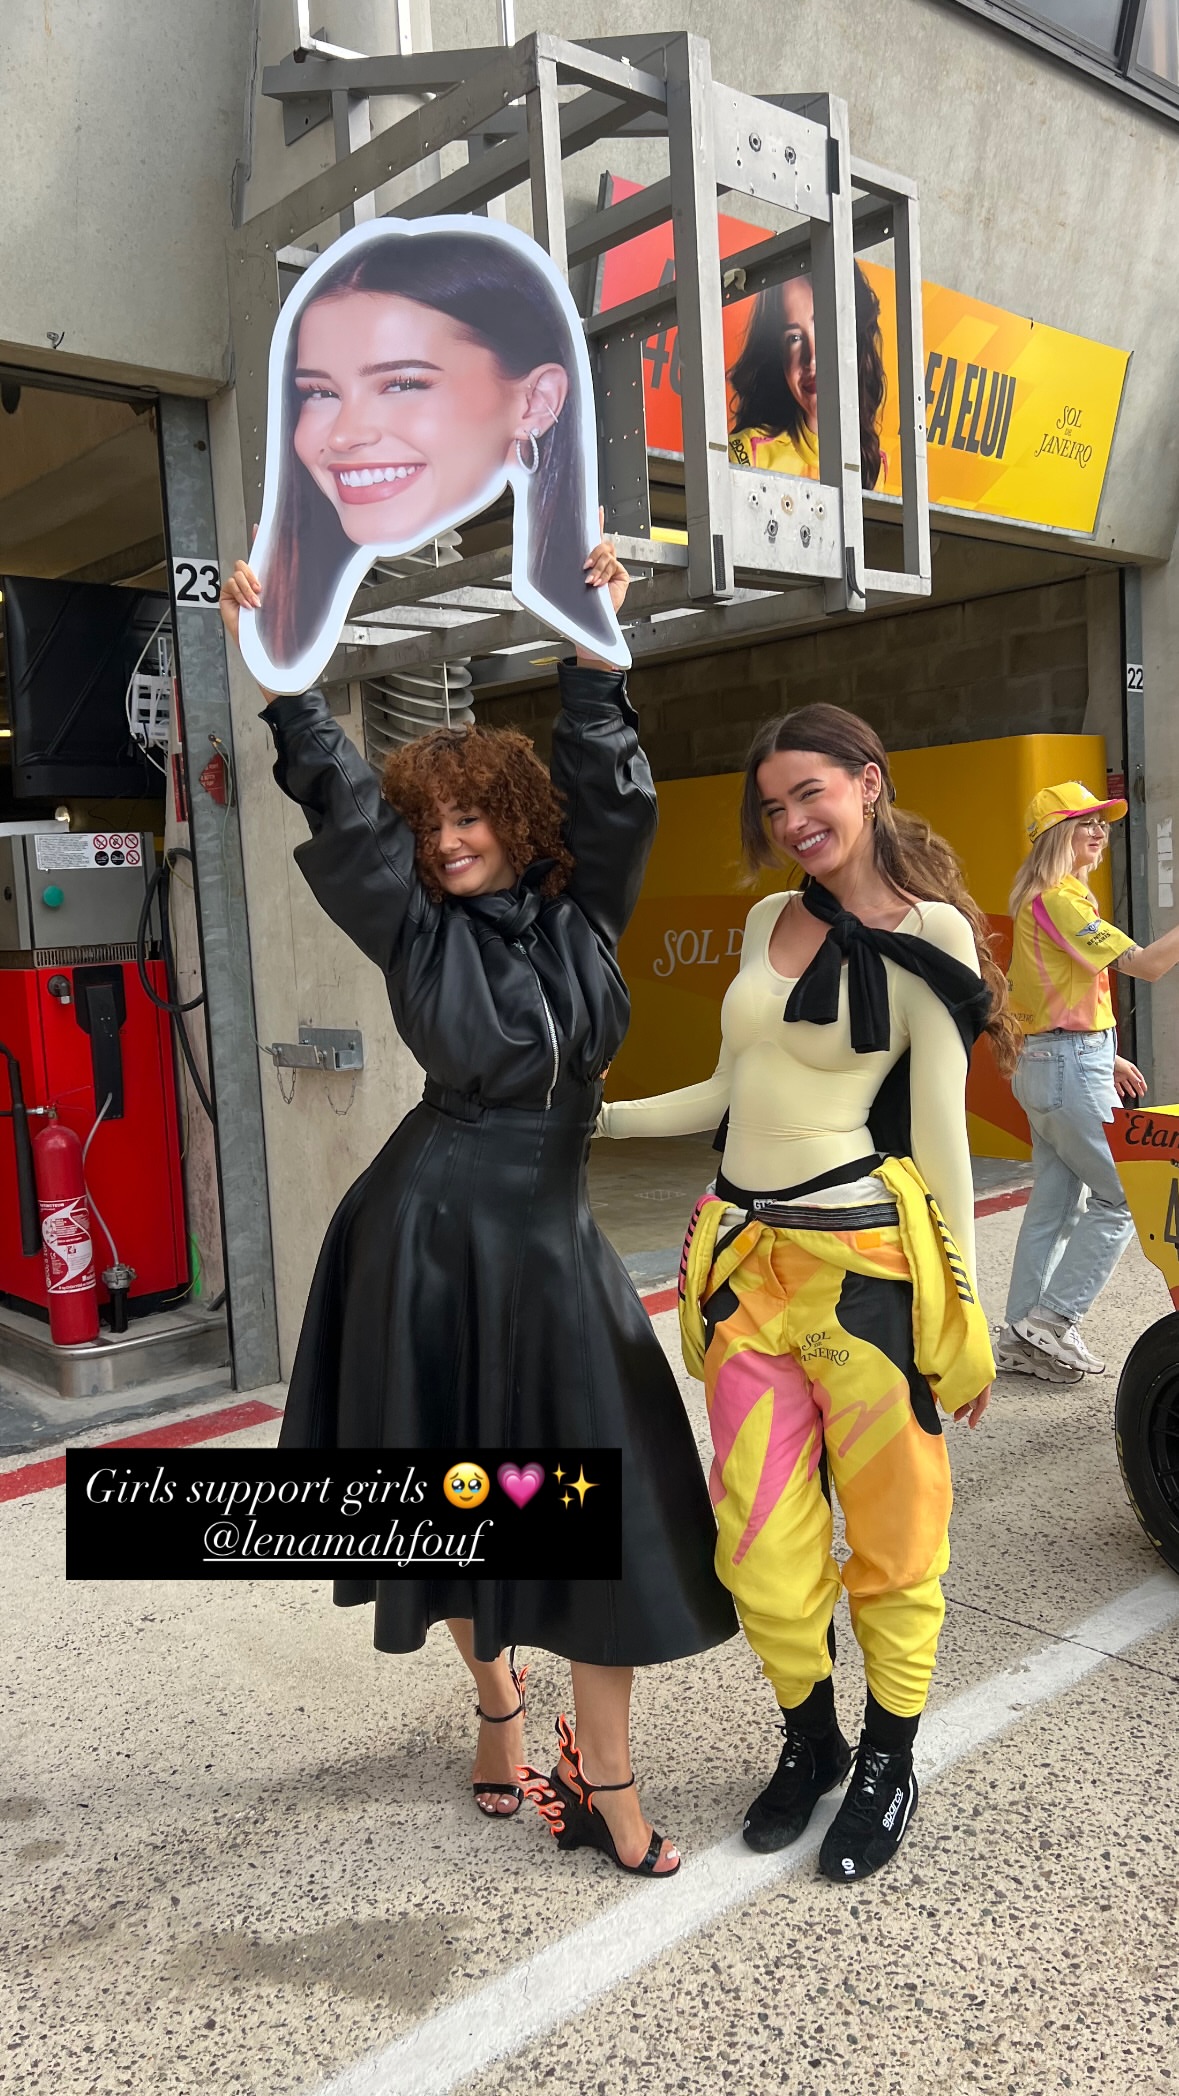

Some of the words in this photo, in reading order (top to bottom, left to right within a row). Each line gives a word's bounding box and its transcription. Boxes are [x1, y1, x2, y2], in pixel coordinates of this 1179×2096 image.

[951, 362, 1017, 460] ELUI
[1056, 405, 1082, 430] SOL
[1034, 433, 1092, 469] JANEIRO
[175, 562, 220, 603] 23
[1128, 667, 1144, 690] 22
[653, 929, 719, 977] SOL
[801, 1331, 831, 1351] SOL
[882, 1787, 904, 1832] sparco
